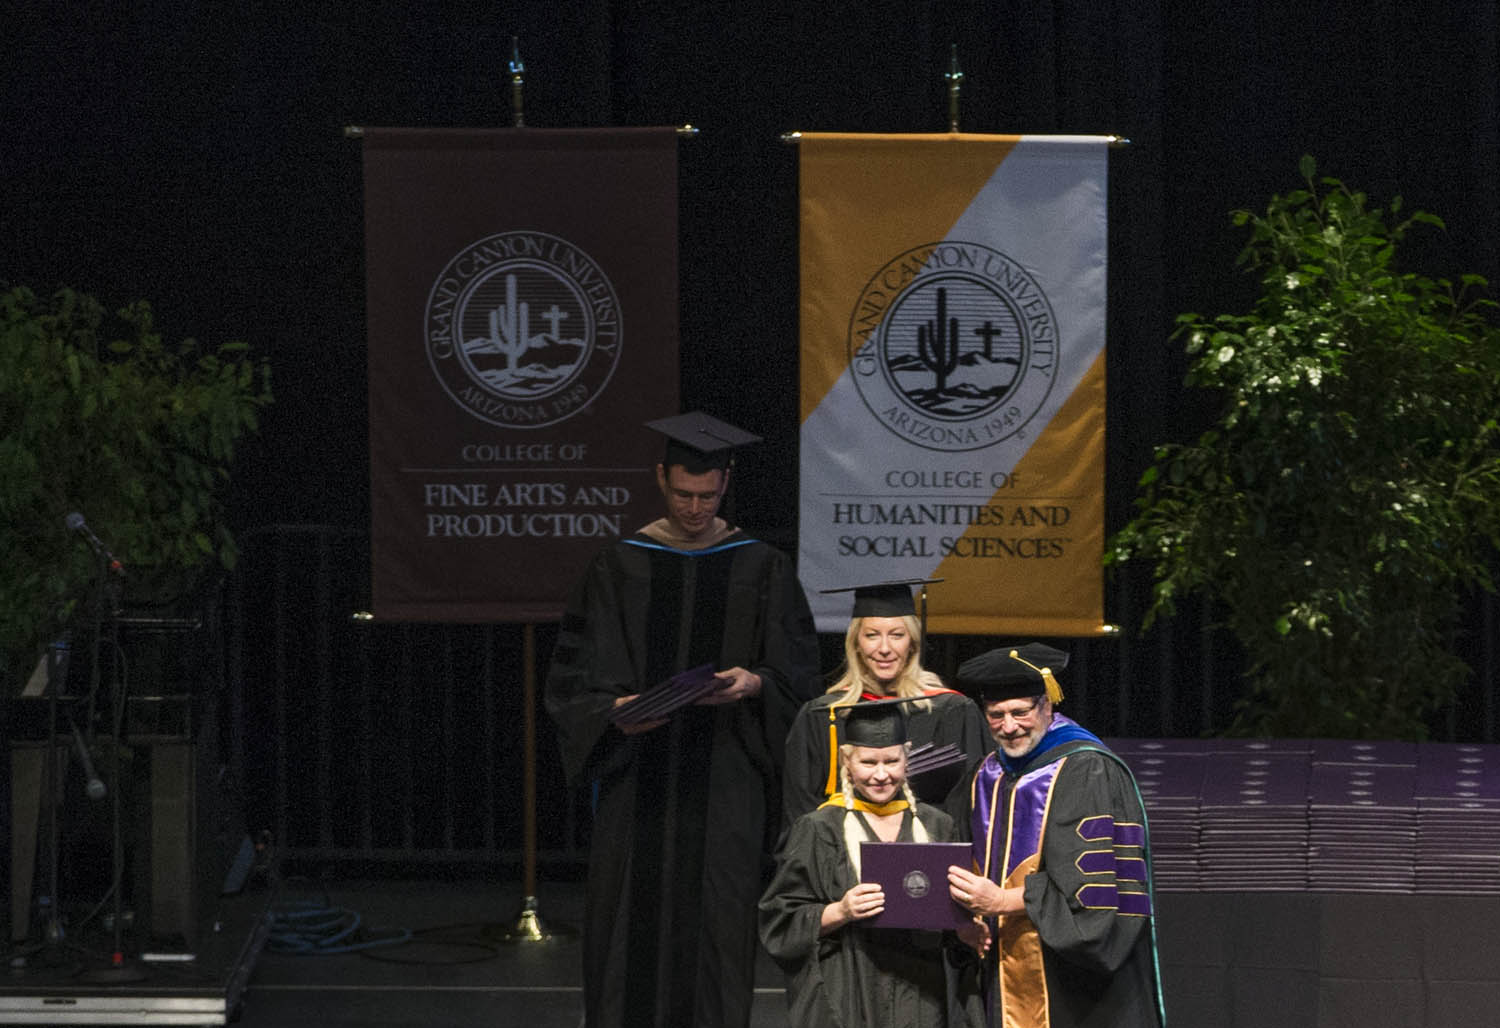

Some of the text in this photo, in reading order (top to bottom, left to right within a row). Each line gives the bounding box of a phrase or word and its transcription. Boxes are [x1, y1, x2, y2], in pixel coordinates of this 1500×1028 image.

[431, 236, 616, 359] GRAND CANYON UNIVERSITY
[855, 246, 1053, 377] GRAND CANYON UNIVERSITY
[458, 387, 548, 420] ARIZONA
[883, 406, 1021, 443] ARIZONA 1949
[462, 444, 588, 462] COLLEGE OF
[885, 470, 1020, 489] COLLEGE OF
[424, 483, 630, 506] FINE ARTS AND
[426, 513, 622, 537] PRODUCTION
[832, 503, 1071, 526] HUMANITIES AND
[838, 535, 1065, 558] SOCIAL SCIENCES
